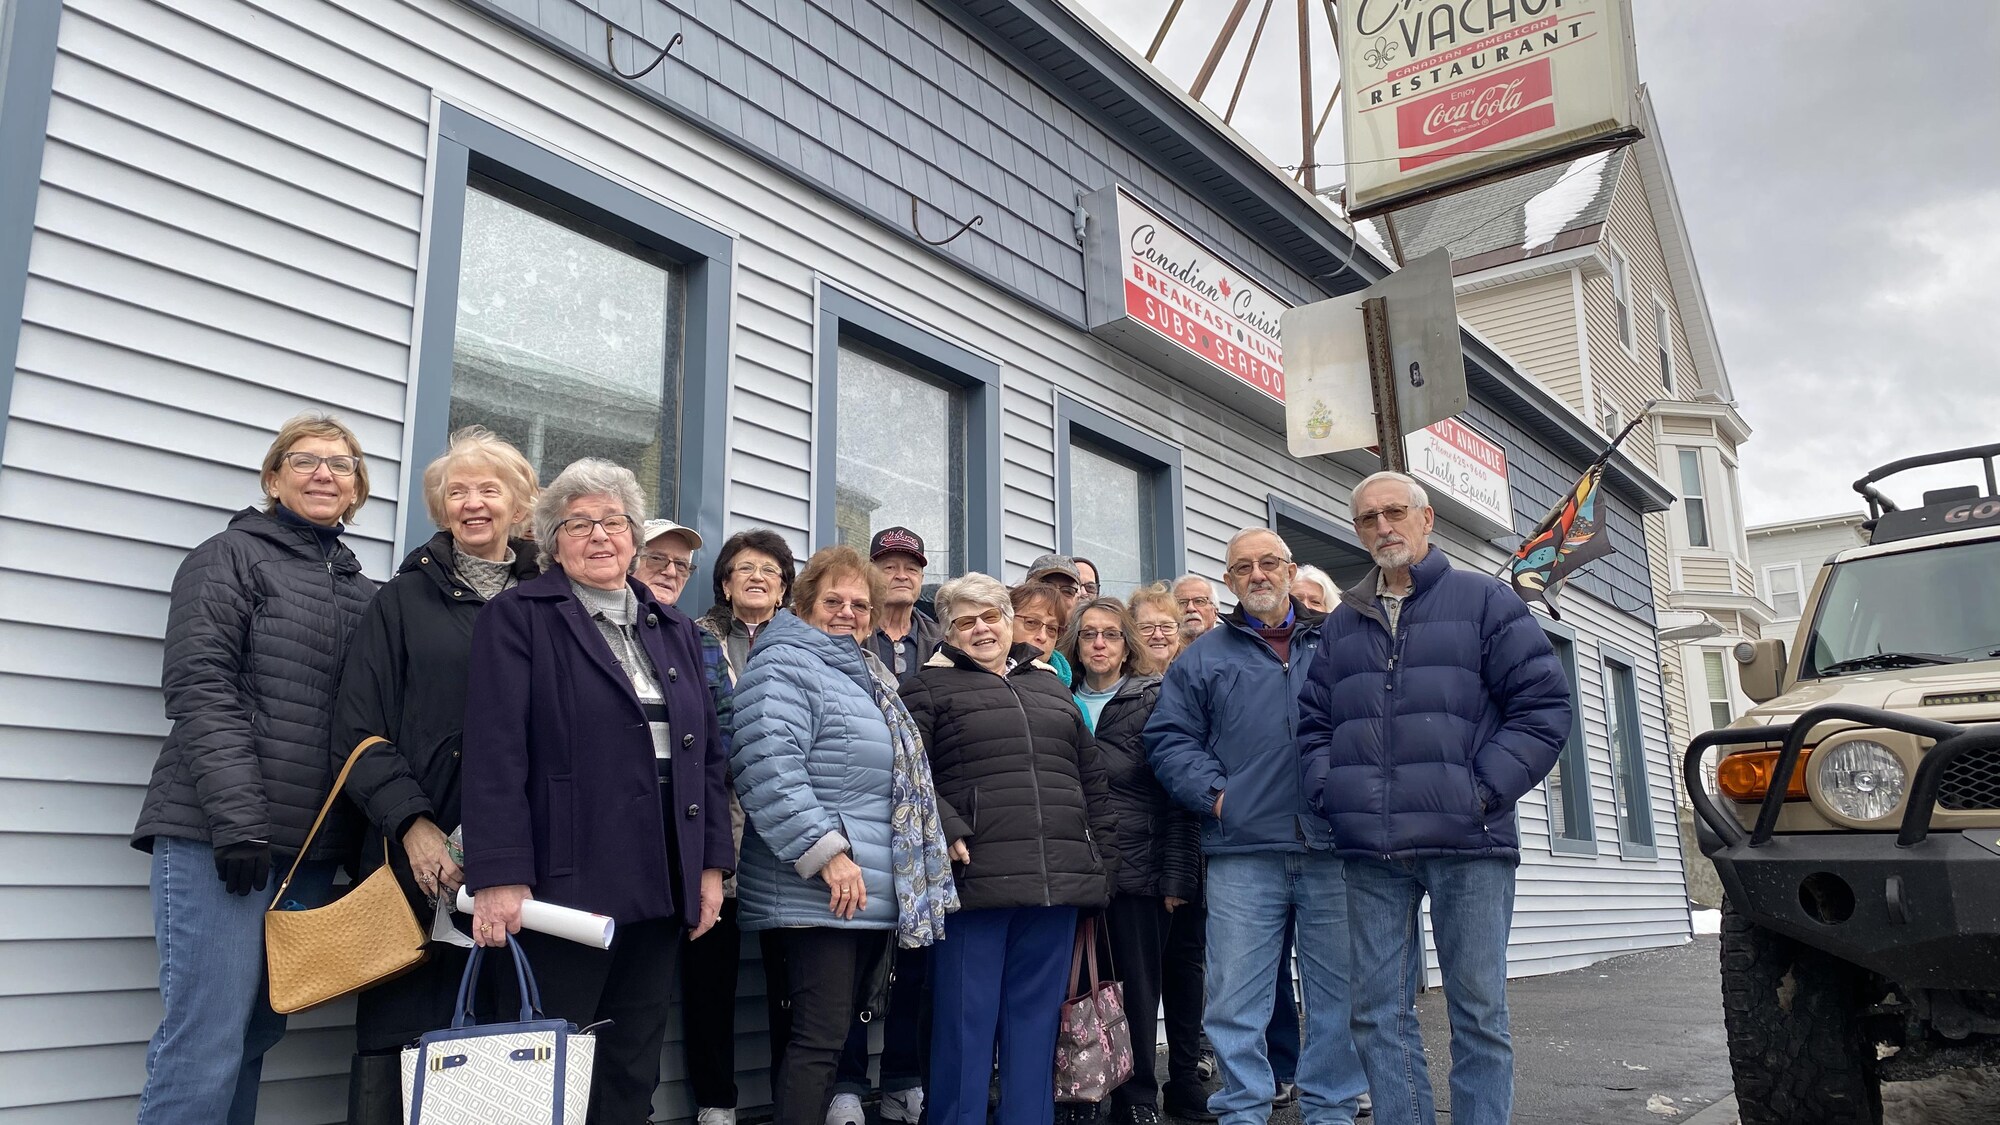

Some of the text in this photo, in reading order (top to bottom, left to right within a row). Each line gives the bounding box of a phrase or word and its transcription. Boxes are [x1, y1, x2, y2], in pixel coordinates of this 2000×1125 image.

[1395, 49, 1462, 77] CANADIAN
[1476, 19, 1550, 50] AMERICAN
[1399, 0, 1562, 58] VACH
[1371, 21, 1582, 105] RESTAURANT
[1450, 87, 1476, 101] Enjoy
[1422, 76, 1527, 136] Coca-Cola
[1130, 224, 1281, 341] Canadian Cuisi
[1133, 263, 1284, 366] BREAKFAST LUNC
[1145, 296, 1282, 394] SUBS SEAFOO
[1423, 447, 1501, 513] Daily Specials
[1456, 428, 1501, 472] AVAILABLE
